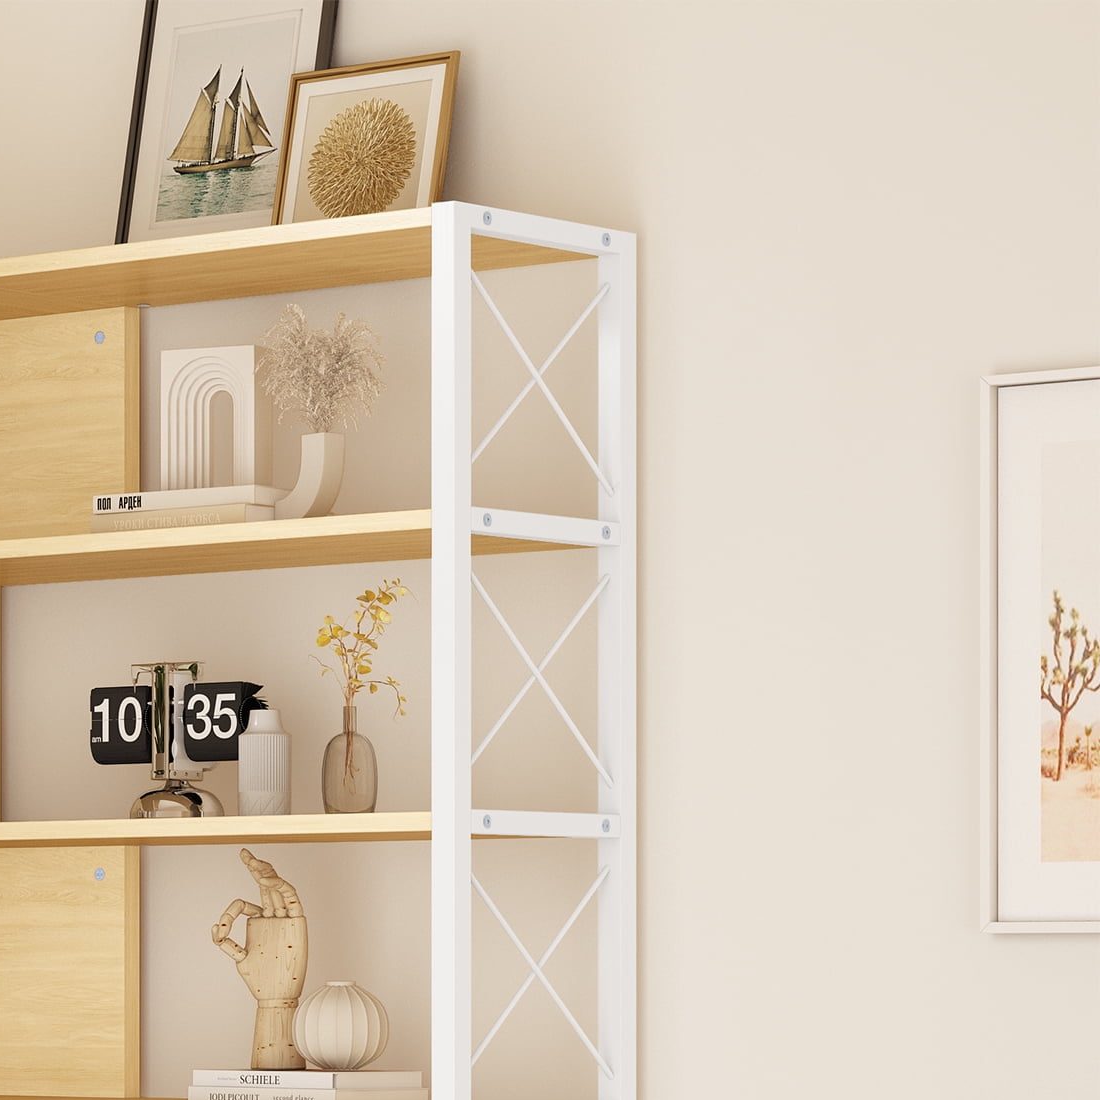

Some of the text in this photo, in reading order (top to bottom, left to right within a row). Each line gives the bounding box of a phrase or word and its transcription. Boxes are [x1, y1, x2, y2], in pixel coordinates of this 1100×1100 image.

[97, 496, 142, 510] ПОЛ АРДЕН
[146, 516, 178, 529] СТИВА
[94, 696, 142, 743] 10
[186, 693, 237, 740] 35
[240, 1075, 280, 1085] SCHIELE
